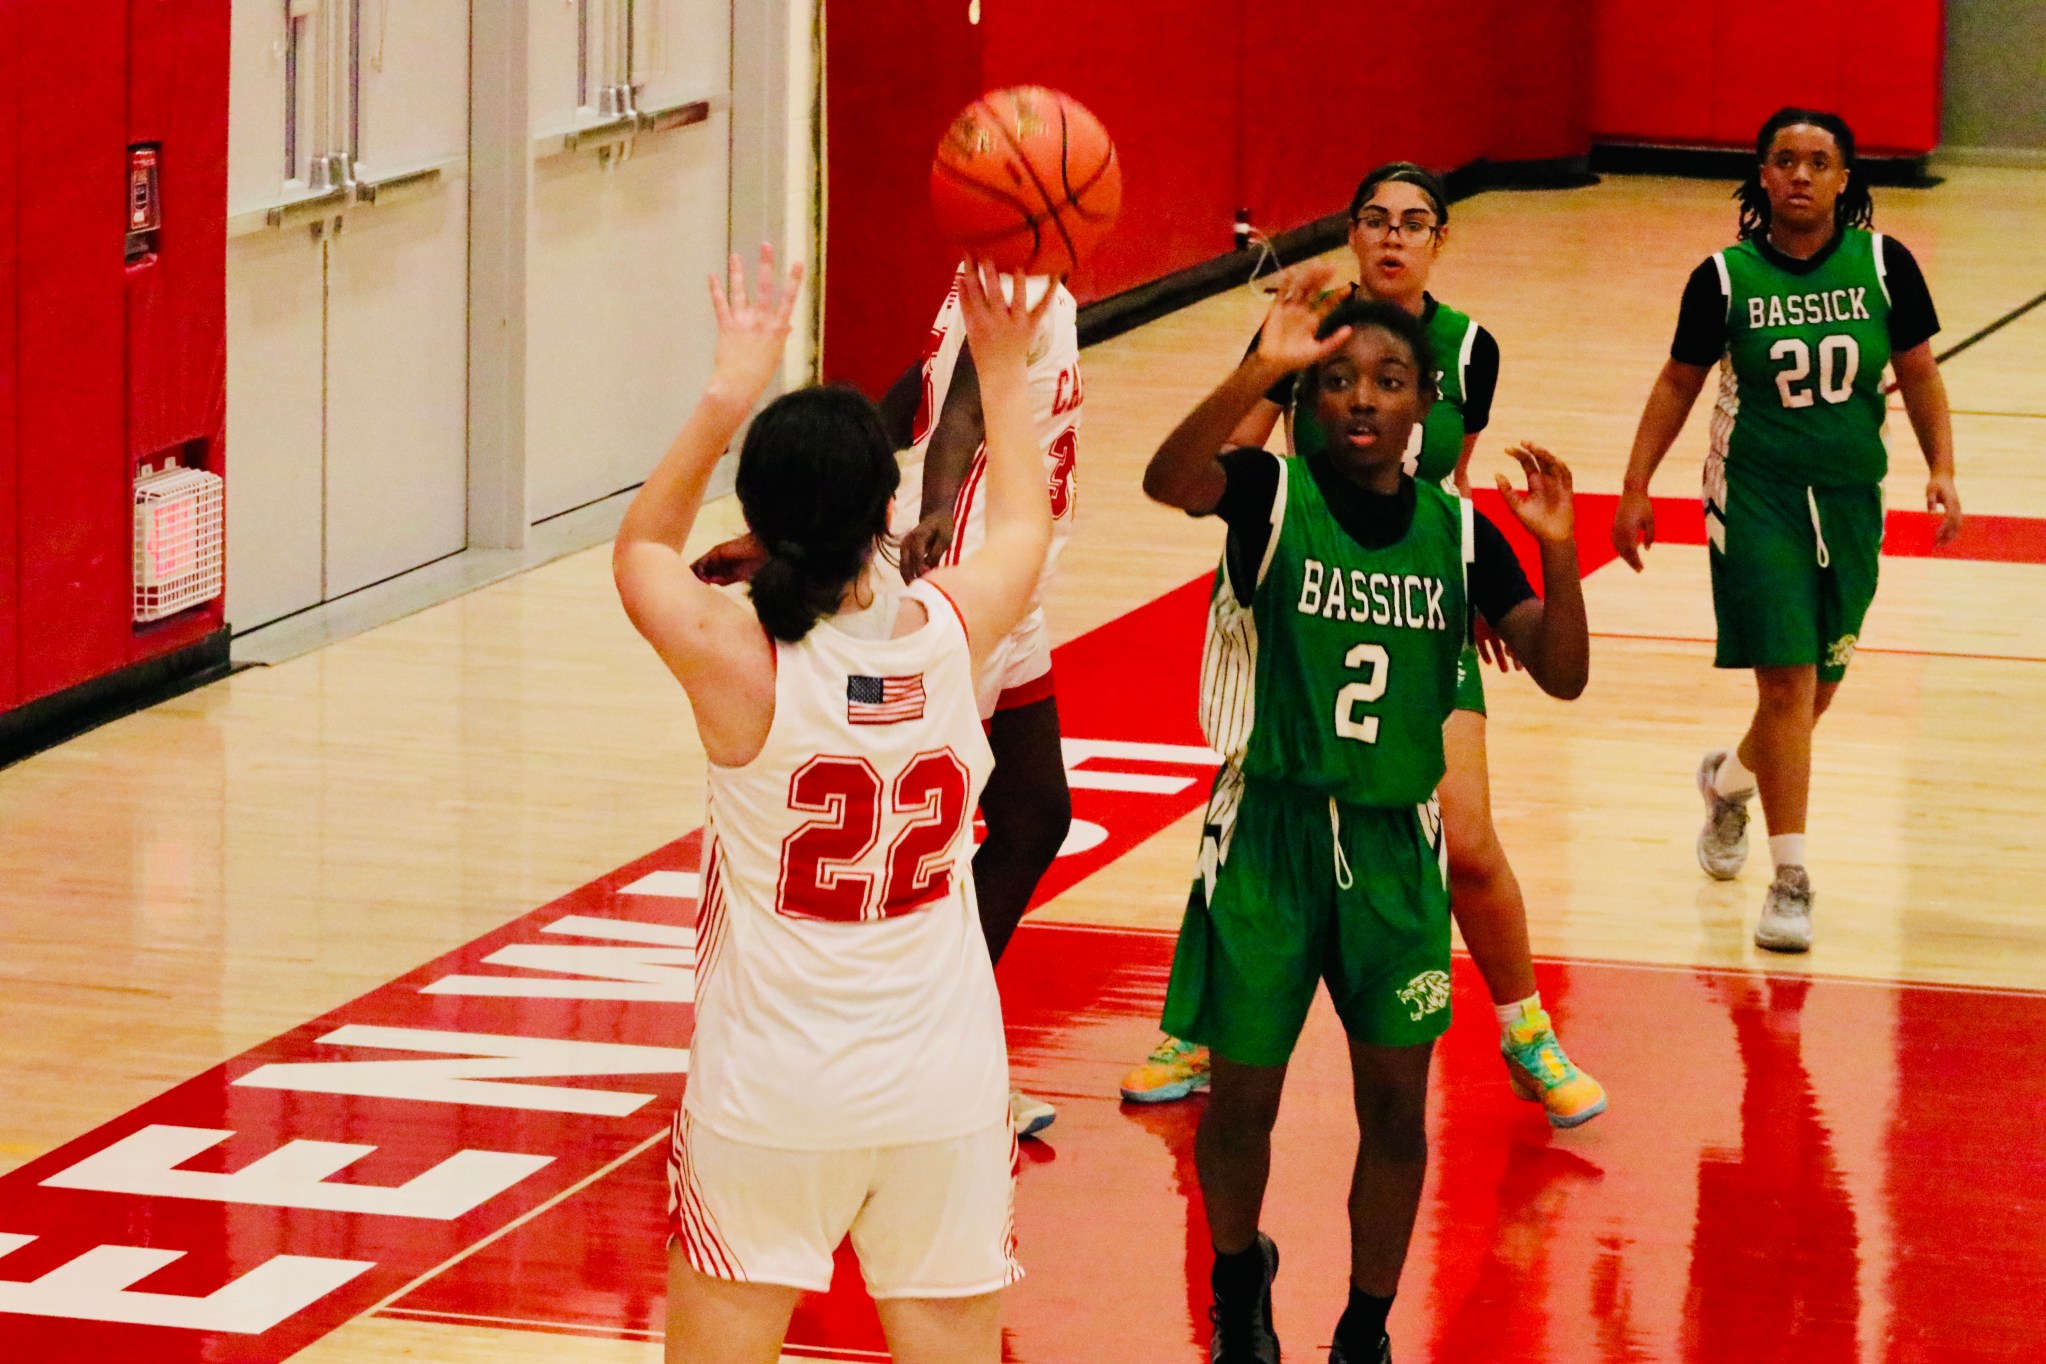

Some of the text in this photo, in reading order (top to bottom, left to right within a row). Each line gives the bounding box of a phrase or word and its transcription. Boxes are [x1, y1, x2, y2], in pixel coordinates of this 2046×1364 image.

[1748, 287, 1870, 328] BASSICK
[1770, 335, 1860, 408] 20
[1298, 559, 1447, 630] BASSICK
[1335, 643, 1390, 744] 2
[776, 746, 969, 922] 22
